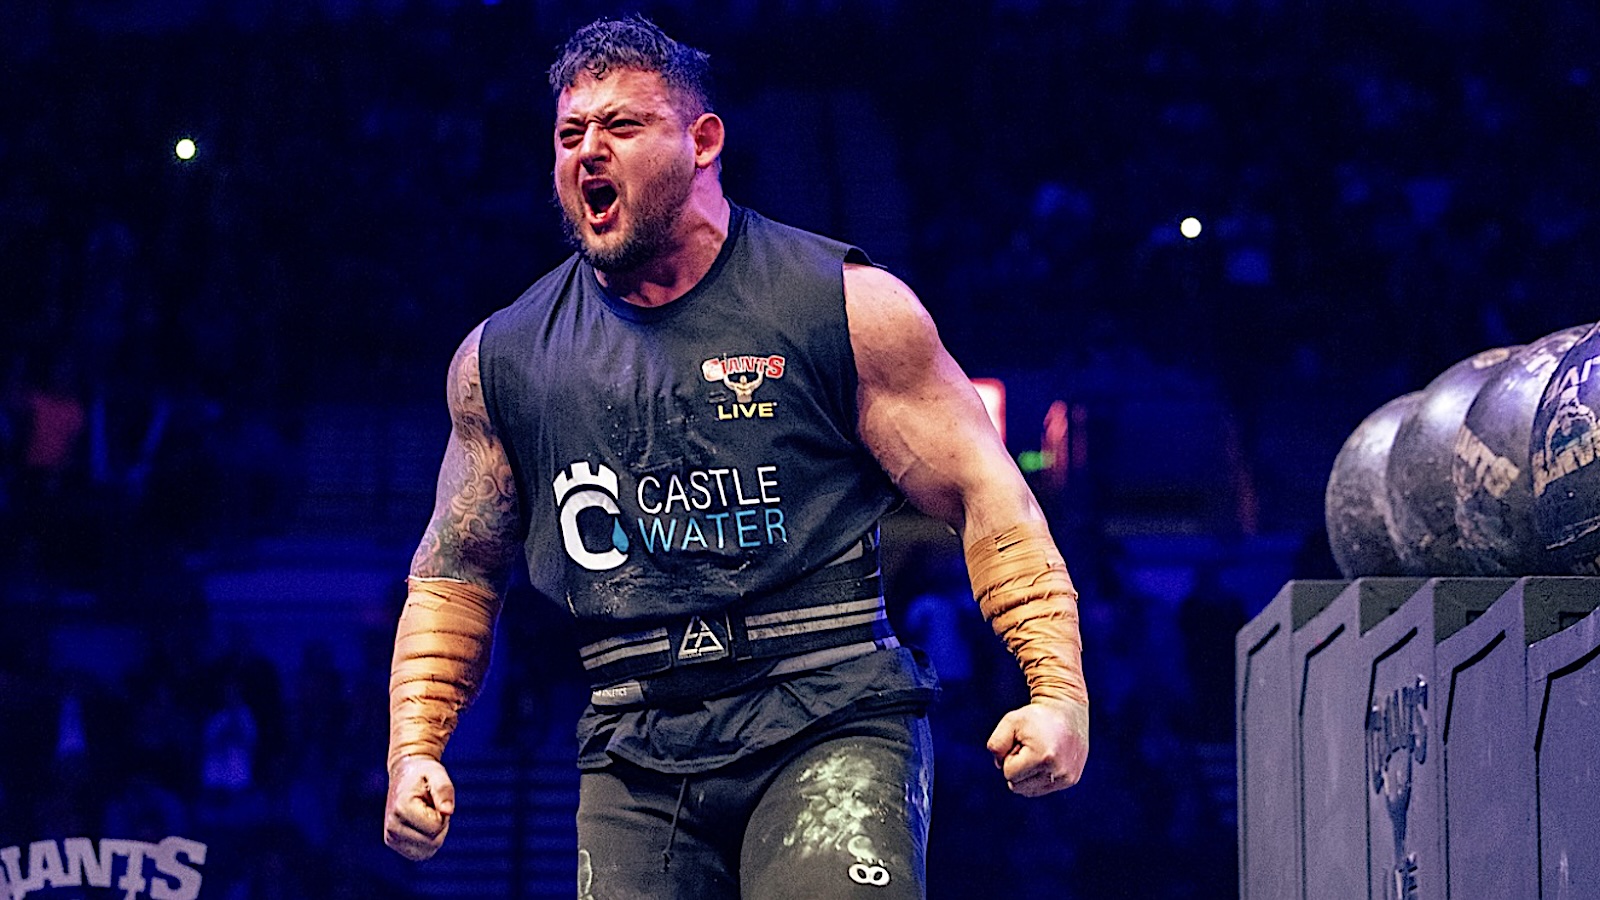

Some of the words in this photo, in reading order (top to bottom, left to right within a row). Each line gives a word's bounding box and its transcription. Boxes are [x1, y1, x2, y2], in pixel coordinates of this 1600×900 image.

[717, 402, 774, 420] LIVE
[637, 466, 781, 514] CASTLE
[638, 508, 788, 553] WATER
[0, 836, 207, 900] IANTS
